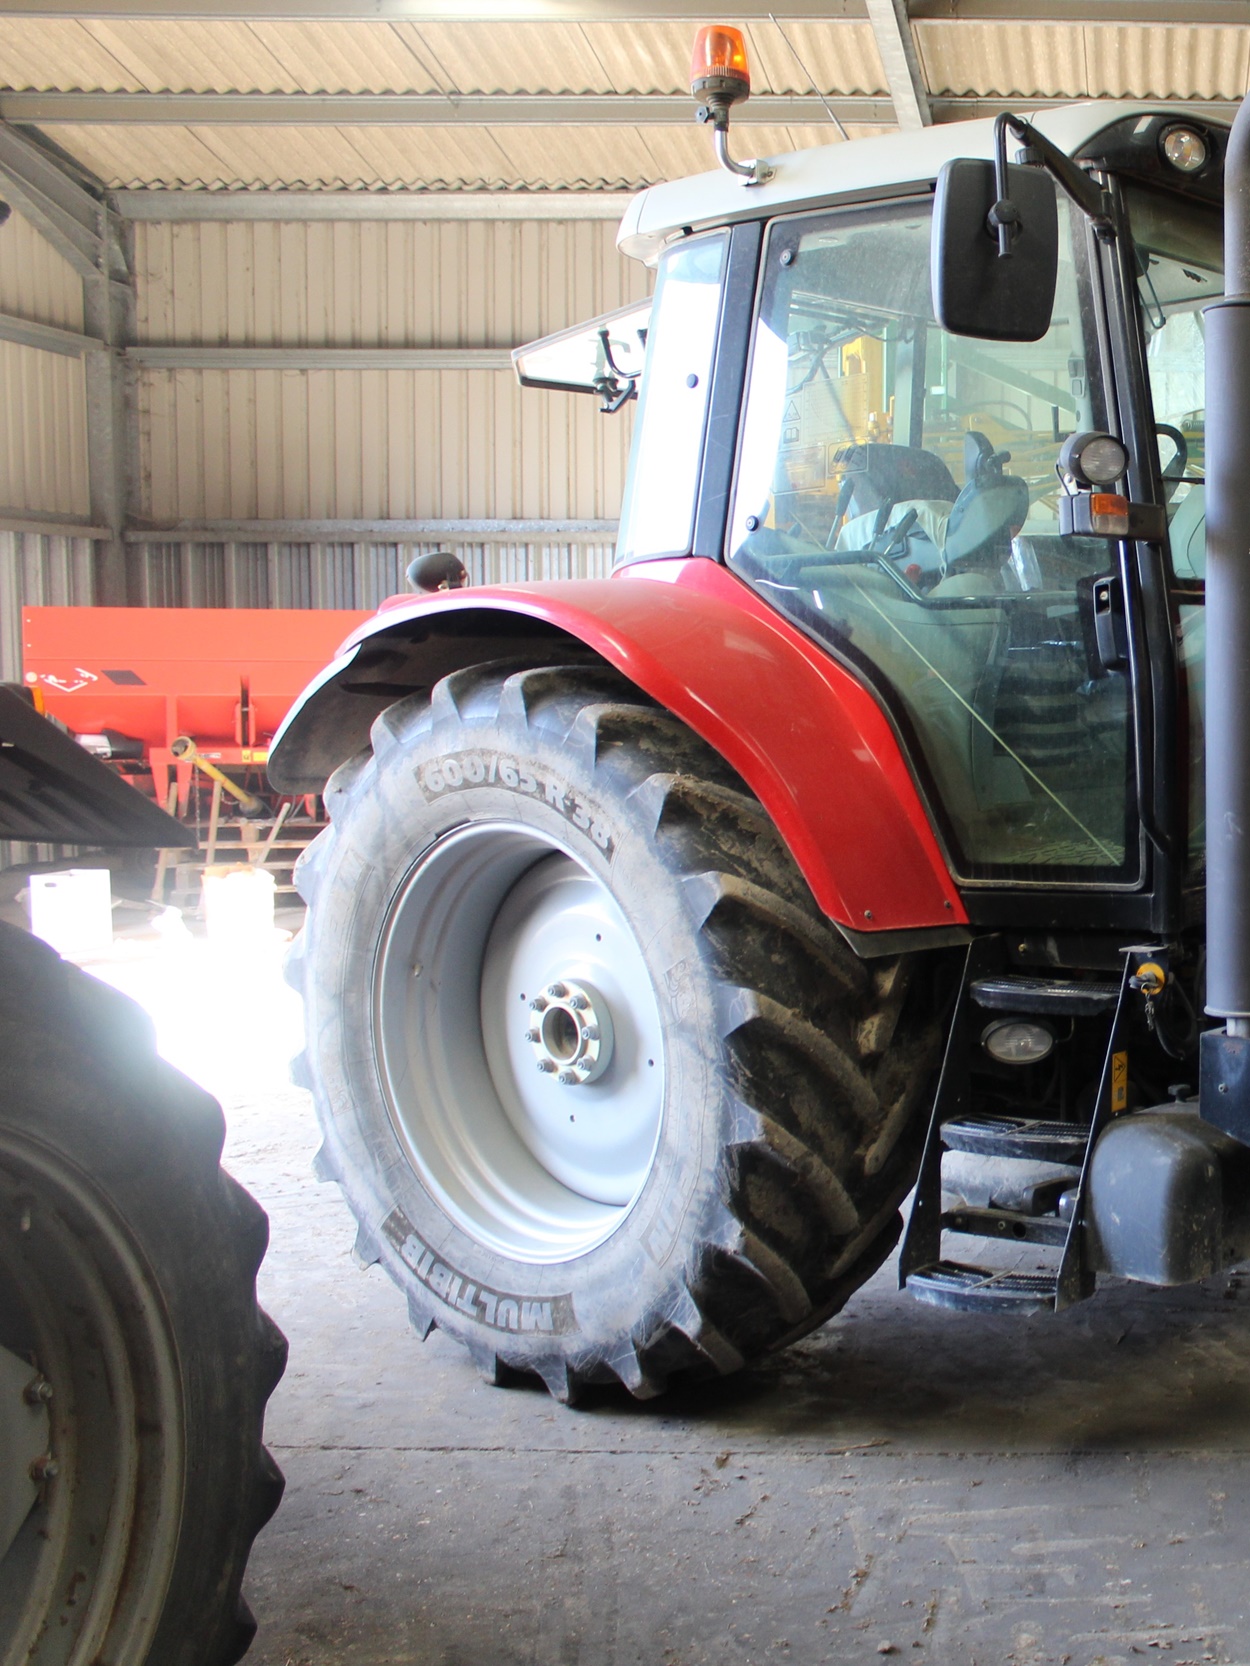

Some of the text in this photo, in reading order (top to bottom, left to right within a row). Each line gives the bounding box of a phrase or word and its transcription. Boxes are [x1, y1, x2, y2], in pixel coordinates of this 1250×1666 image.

[424, 755, 537, 793] 600/65
[571, 796, 612, 849] 38
[401, 1233, 554, 1331] MULTIBIB
